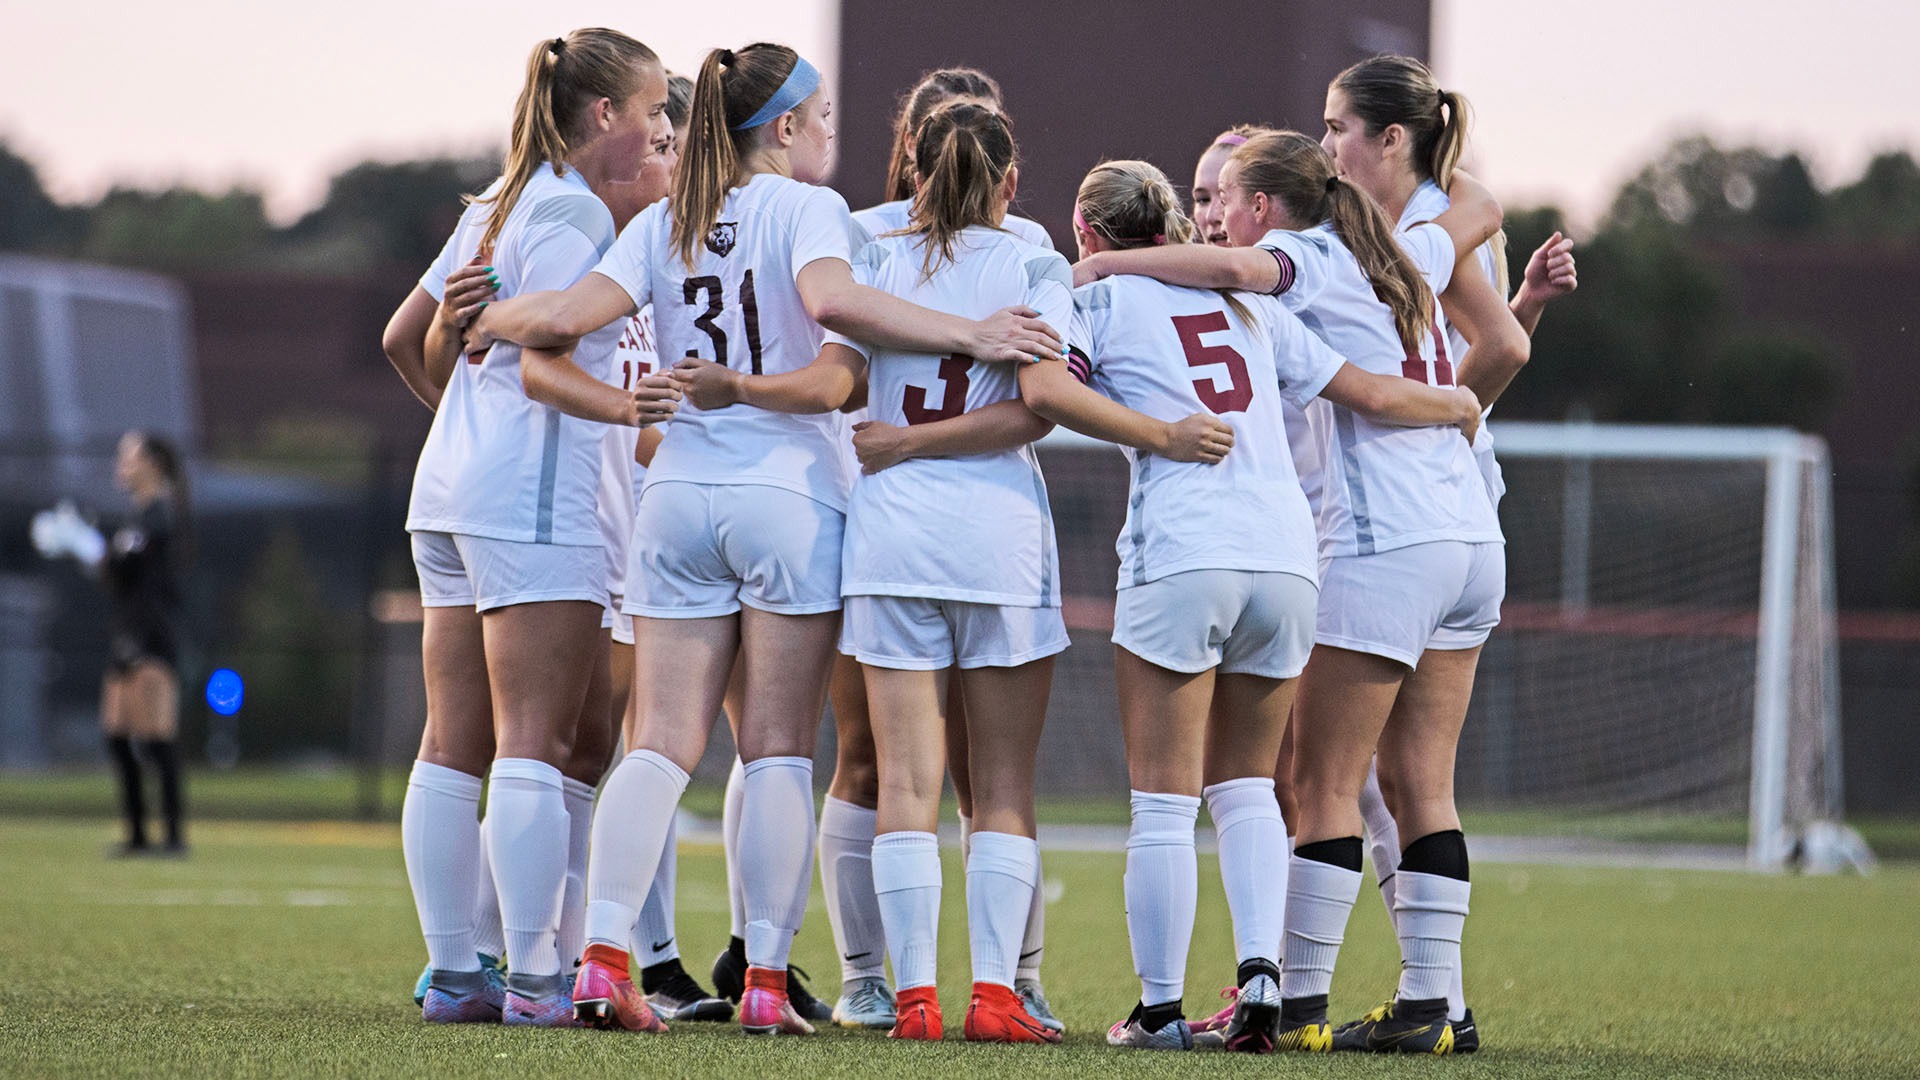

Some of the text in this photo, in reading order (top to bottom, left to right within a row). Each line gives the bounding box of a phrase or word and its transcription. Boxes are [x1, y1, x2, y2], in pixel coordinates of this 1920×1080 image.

[683, 269, 763, 375] 31
[1170, 310, 1254, 415] 5
[902, 352, 975, 426] 3
